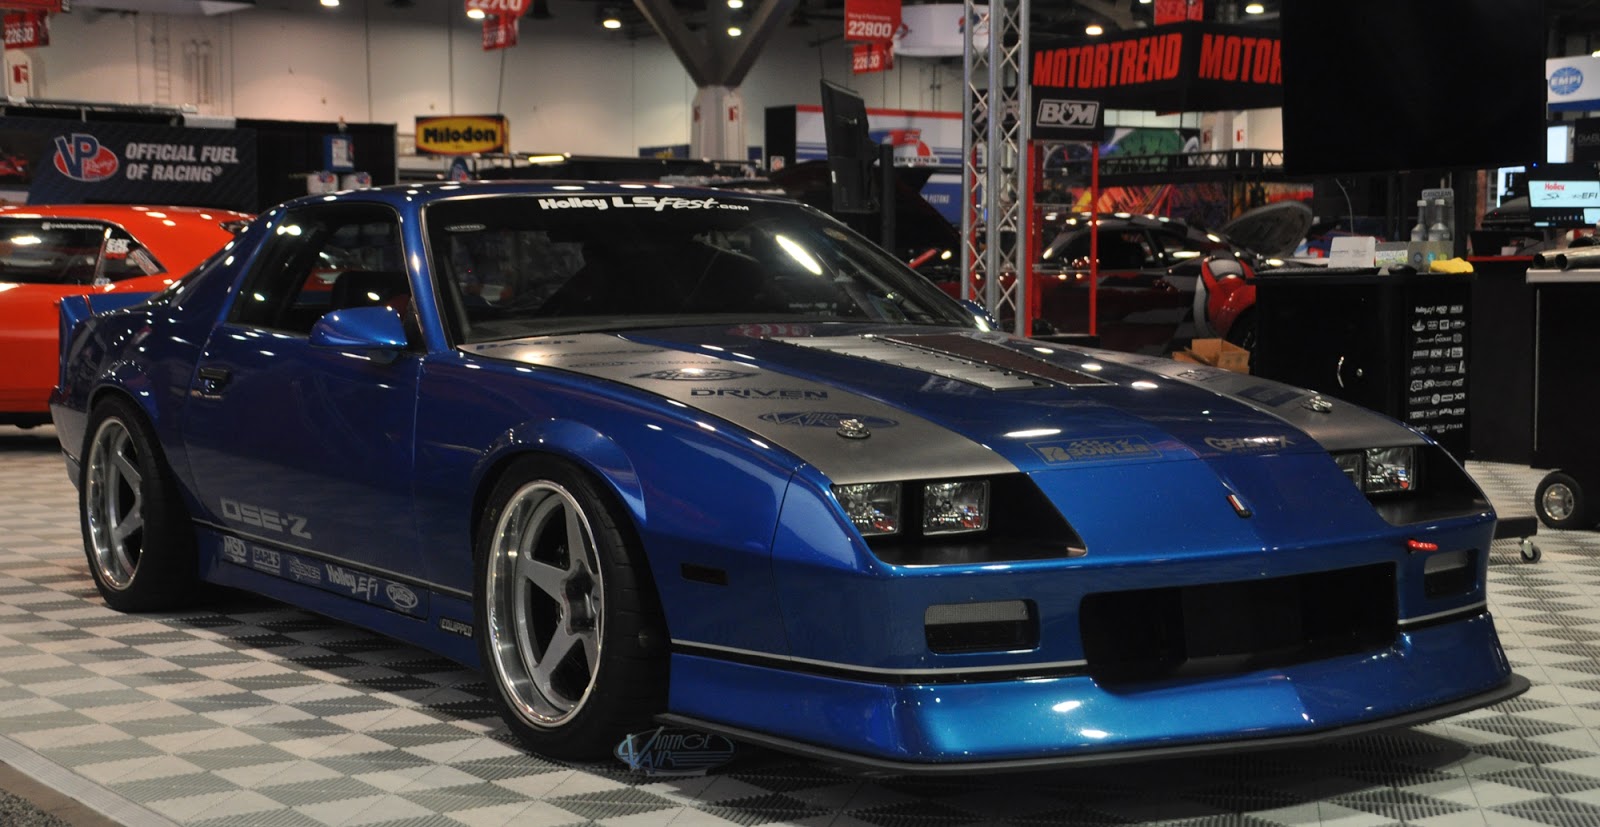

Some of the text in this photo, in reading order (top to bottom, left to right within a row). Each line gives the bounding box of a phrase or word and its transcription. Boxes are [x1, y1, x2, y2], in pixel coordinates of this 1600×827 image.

[848, 20, 892, 37] 22800
[1032, 32, 1183, 89] MOTORTREND
[1551, 75, 1581, 87] EMPI
[1039, 102, 1098, 126] B&M
[423, 126, 496, 143] Milodon
[54, 133, 99, 180] VP
[125, 142, 240, 164] OFFICIAL FUEL
[126, 163, 150, 181] OF
[538, 197, 609, 210] Holley
[690, 388, 829, 399] DRIVEN
[325, 564, 358, 594] Holley
